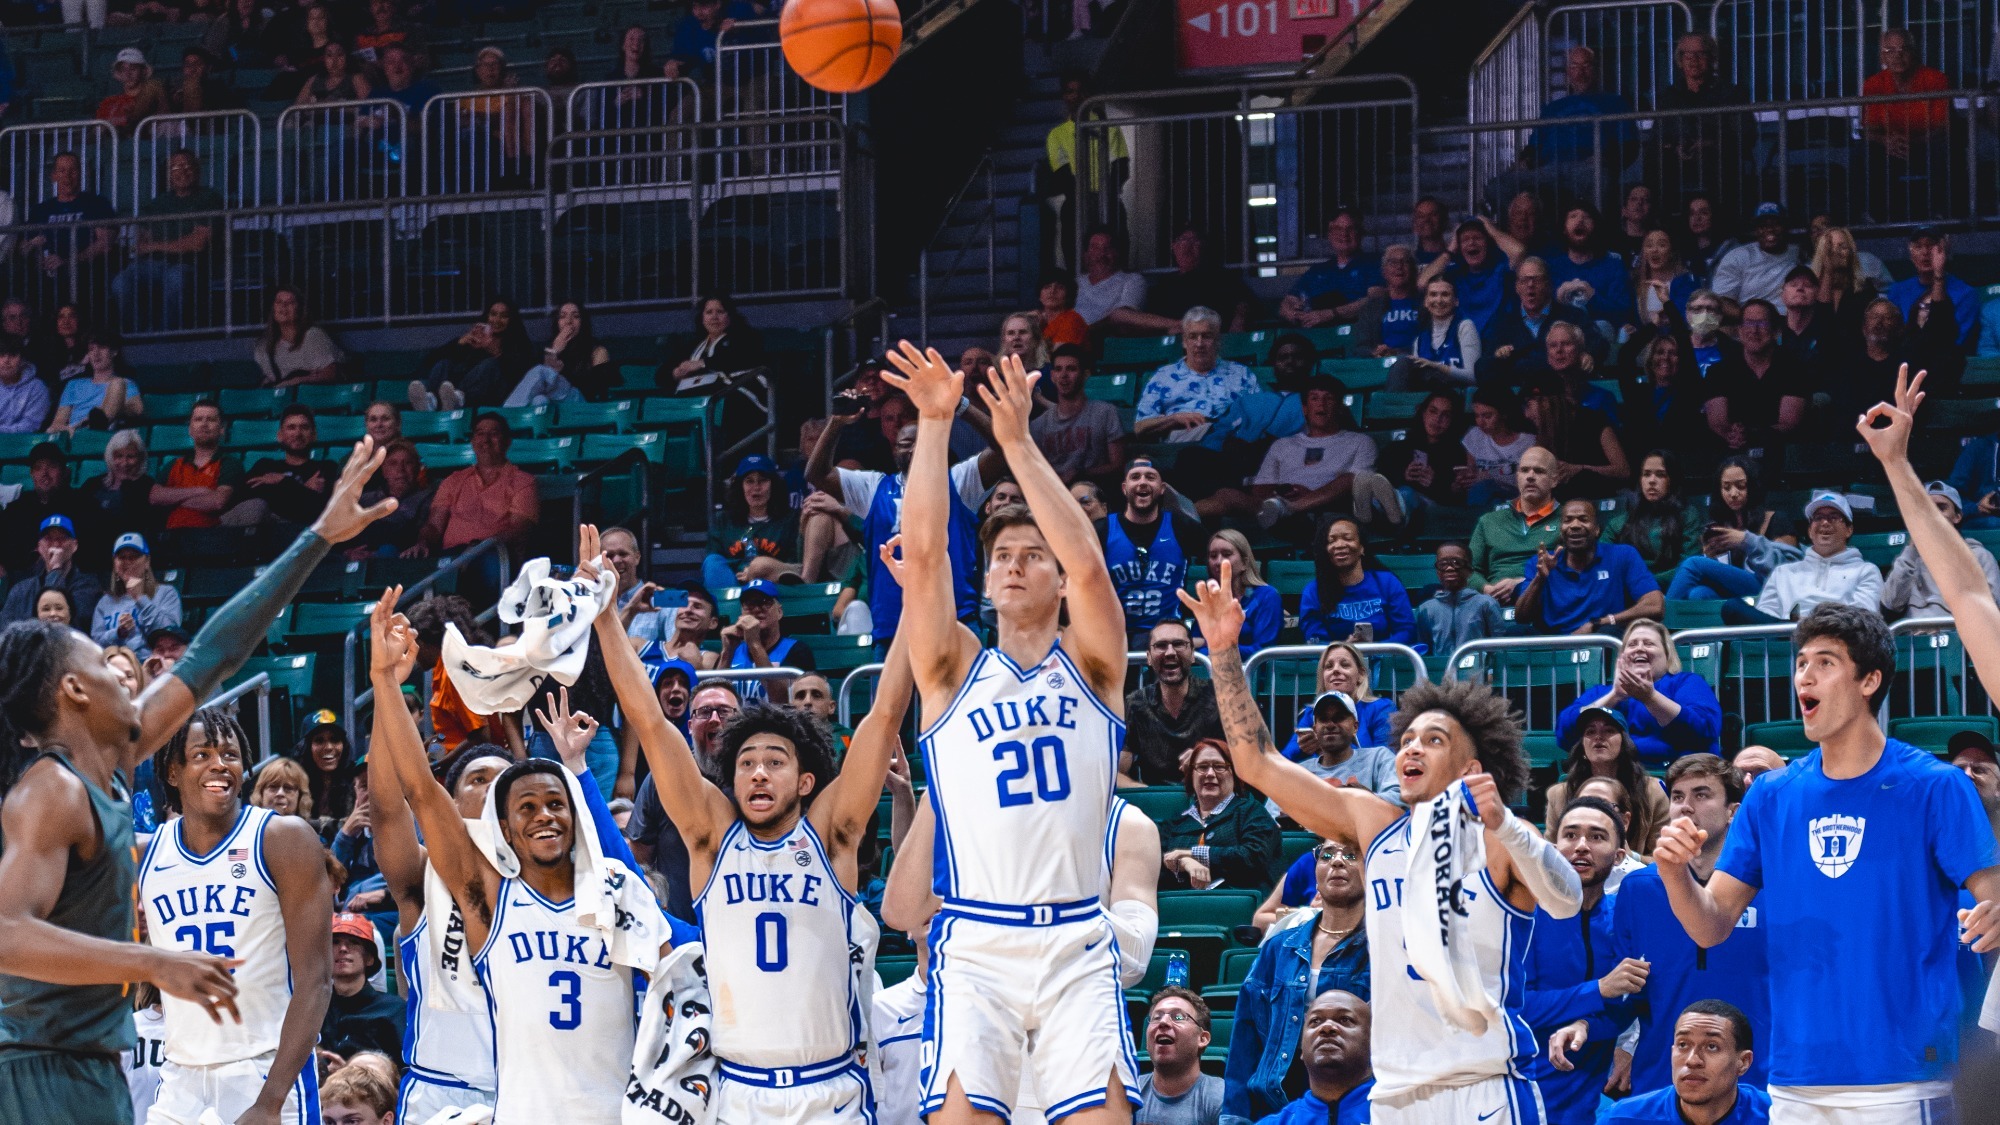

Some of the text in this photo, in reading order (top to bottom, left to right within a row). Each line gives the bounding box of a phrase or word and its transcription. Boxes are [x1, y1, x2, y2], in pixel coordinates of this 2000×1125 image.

[1217, 1, 1277, 38] 101
[1383, 309, 1418, 323] UKE
[1111, 560, 1177, 586] DUKE
[1126, 589, 1163, 616] 22
[1330, 598, 1383, 620] UKE
[967, 695, 1078, 743] DUKE
[992, 735, 1071, 808] 20
[152, 884, 256, 925] DUKE
[723, 872, 821, 907] DUKE
[1032, 906, 1053, 925] D
[508, 931, 613, 970] DUKE
[755, 912, 788, 973] 0
[549, 970, 582, 1031] 3
[134, 1037, 166, 1069] DU
[774, 1069, 794, 1087] D
